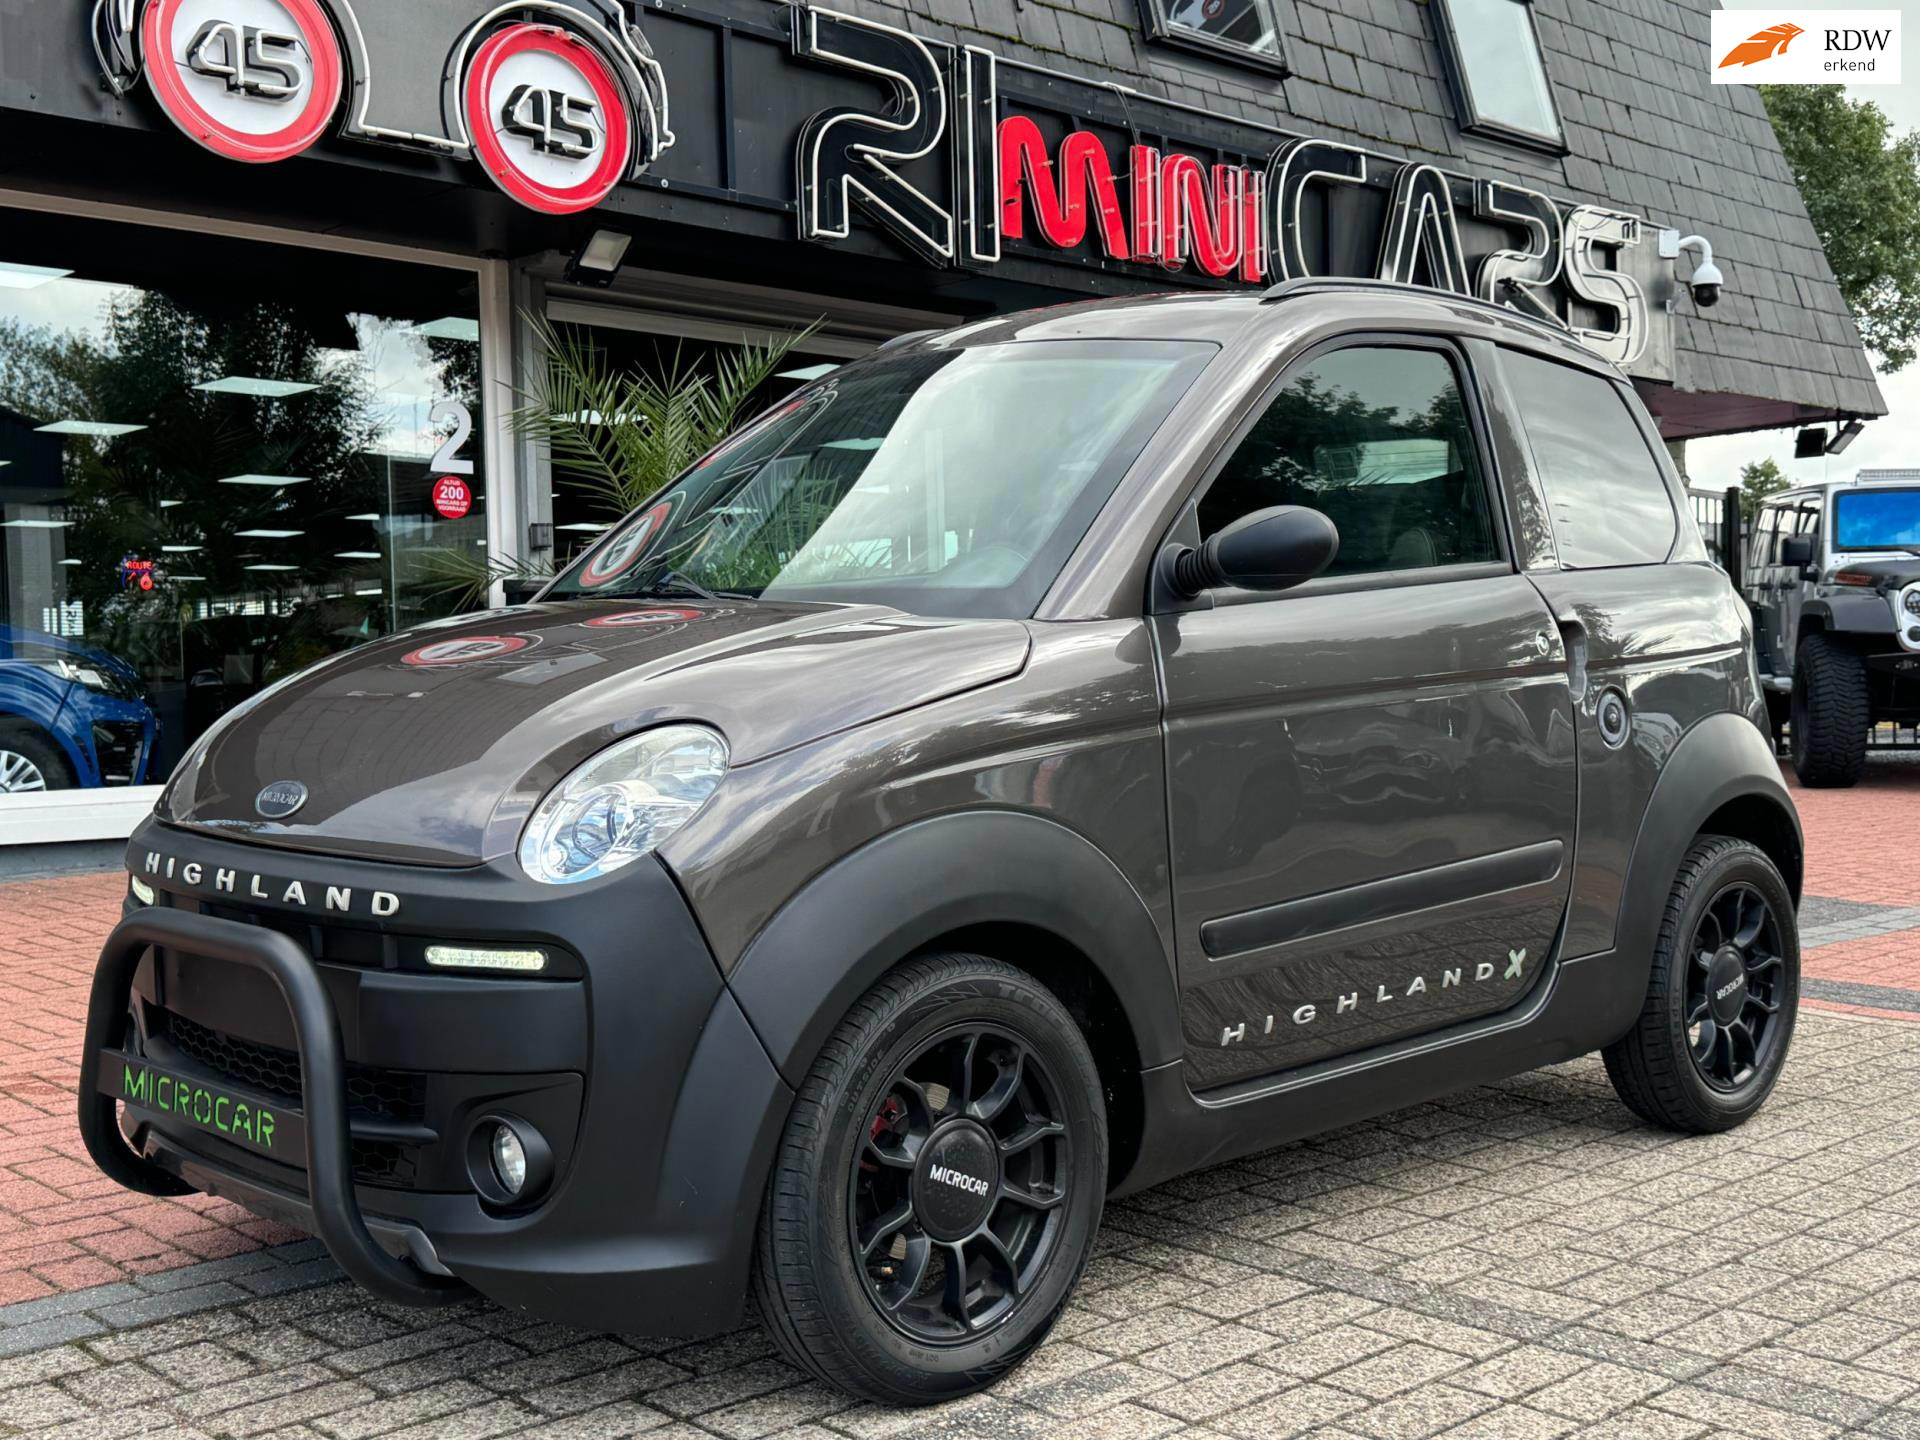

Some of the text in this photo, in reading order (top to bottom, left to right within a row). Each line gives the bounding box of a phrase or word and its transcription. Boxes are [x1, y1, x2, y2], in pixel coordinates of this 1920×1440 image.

[185, 19, 304, 103] 45
[501, 84, 600, 160] 45
[429, 400, 475, 475] 2
[439, 485, 464, 500] 200
[145, 851, 400, 917] HIGHLAND
[124, 1063, 275, 1148] MICROCAR
[929, 1163, 989, 1197] MICROCAR
